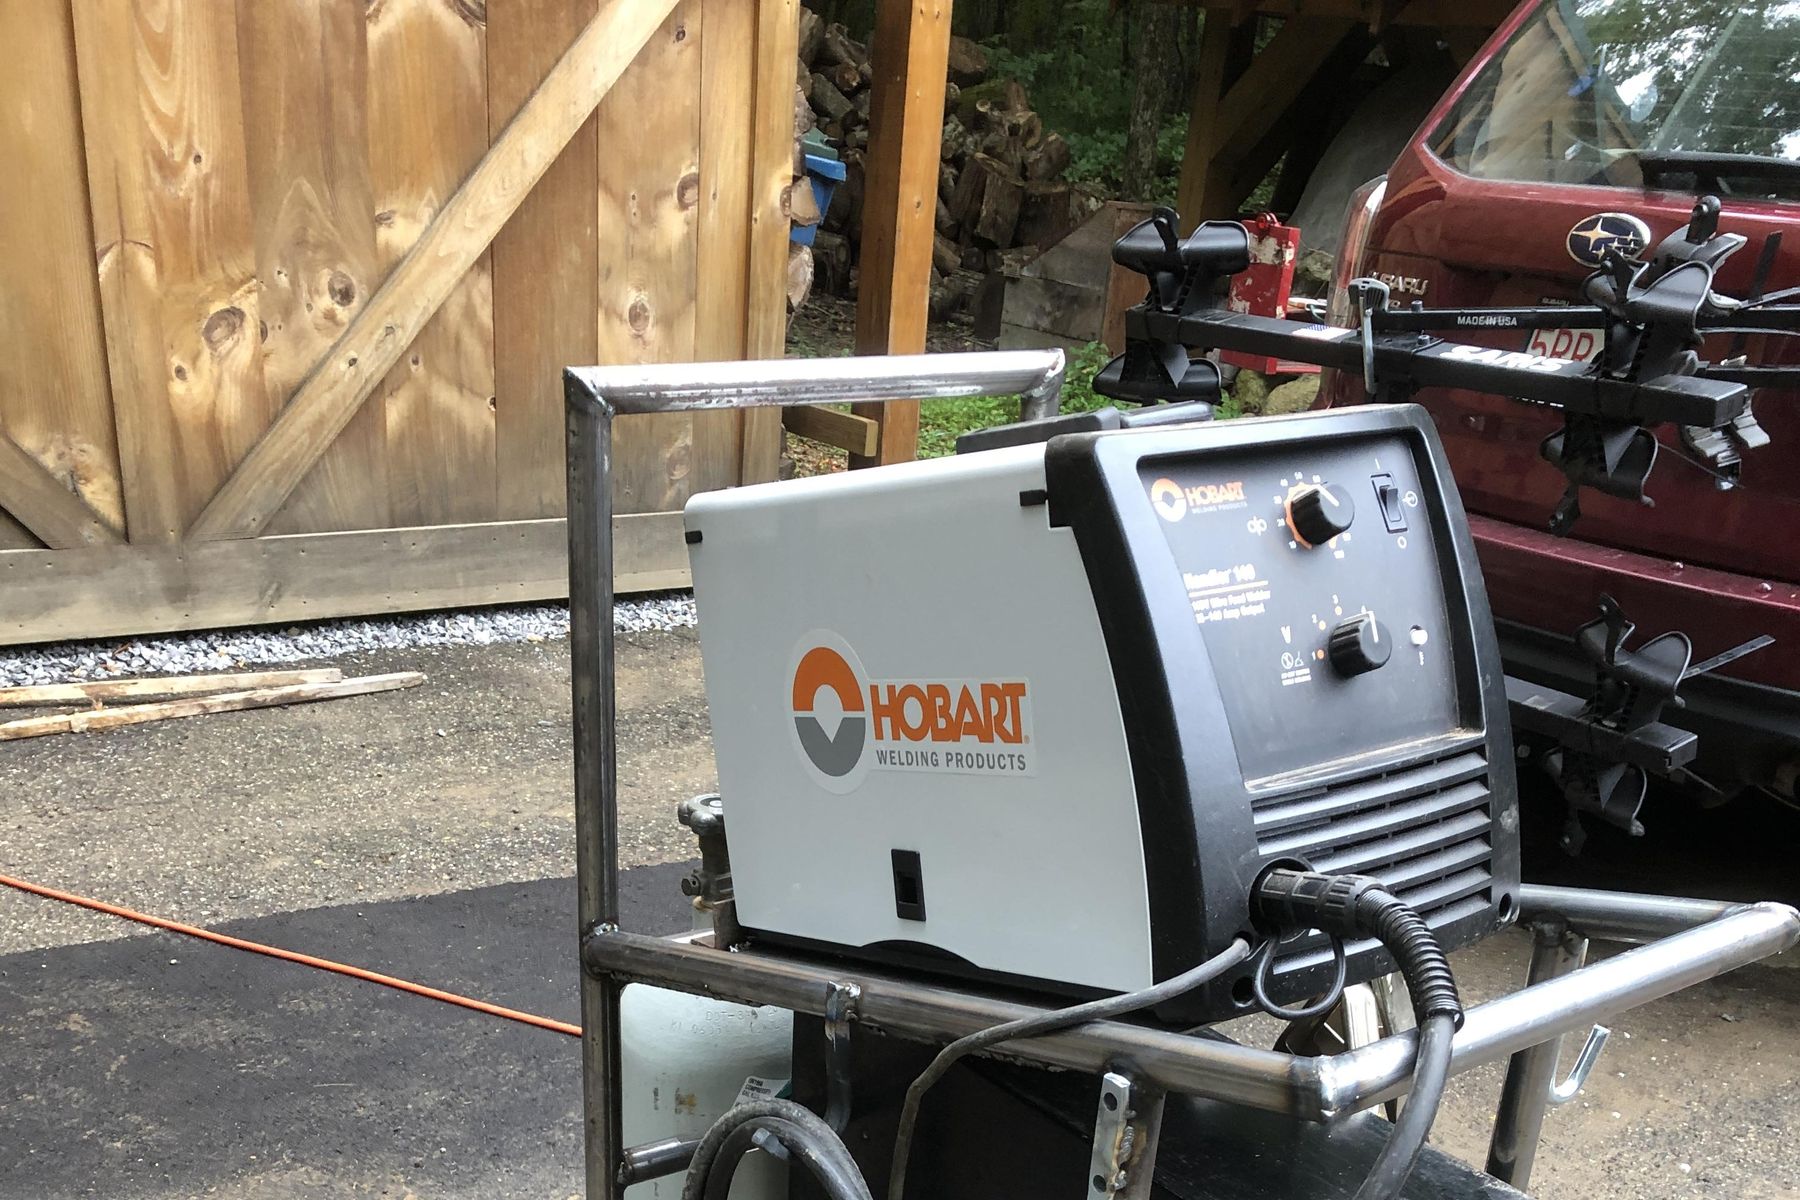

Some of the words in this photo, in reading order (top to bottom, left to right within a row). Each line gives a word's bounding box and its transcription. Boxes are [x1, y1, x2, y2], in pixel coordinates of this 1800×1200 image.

[1457, 315, 1485, 326] MADE
[1485, 316, 1497, 326] IN
[1498, 315, 1518, 327] USA
[1185, 482, 1246, 507] HOBART
[869, 683, 1027, 744] HOBART
[876, 749, 939, 768] WELDING
[945, 751, 1027, 771] PRODUCTS
